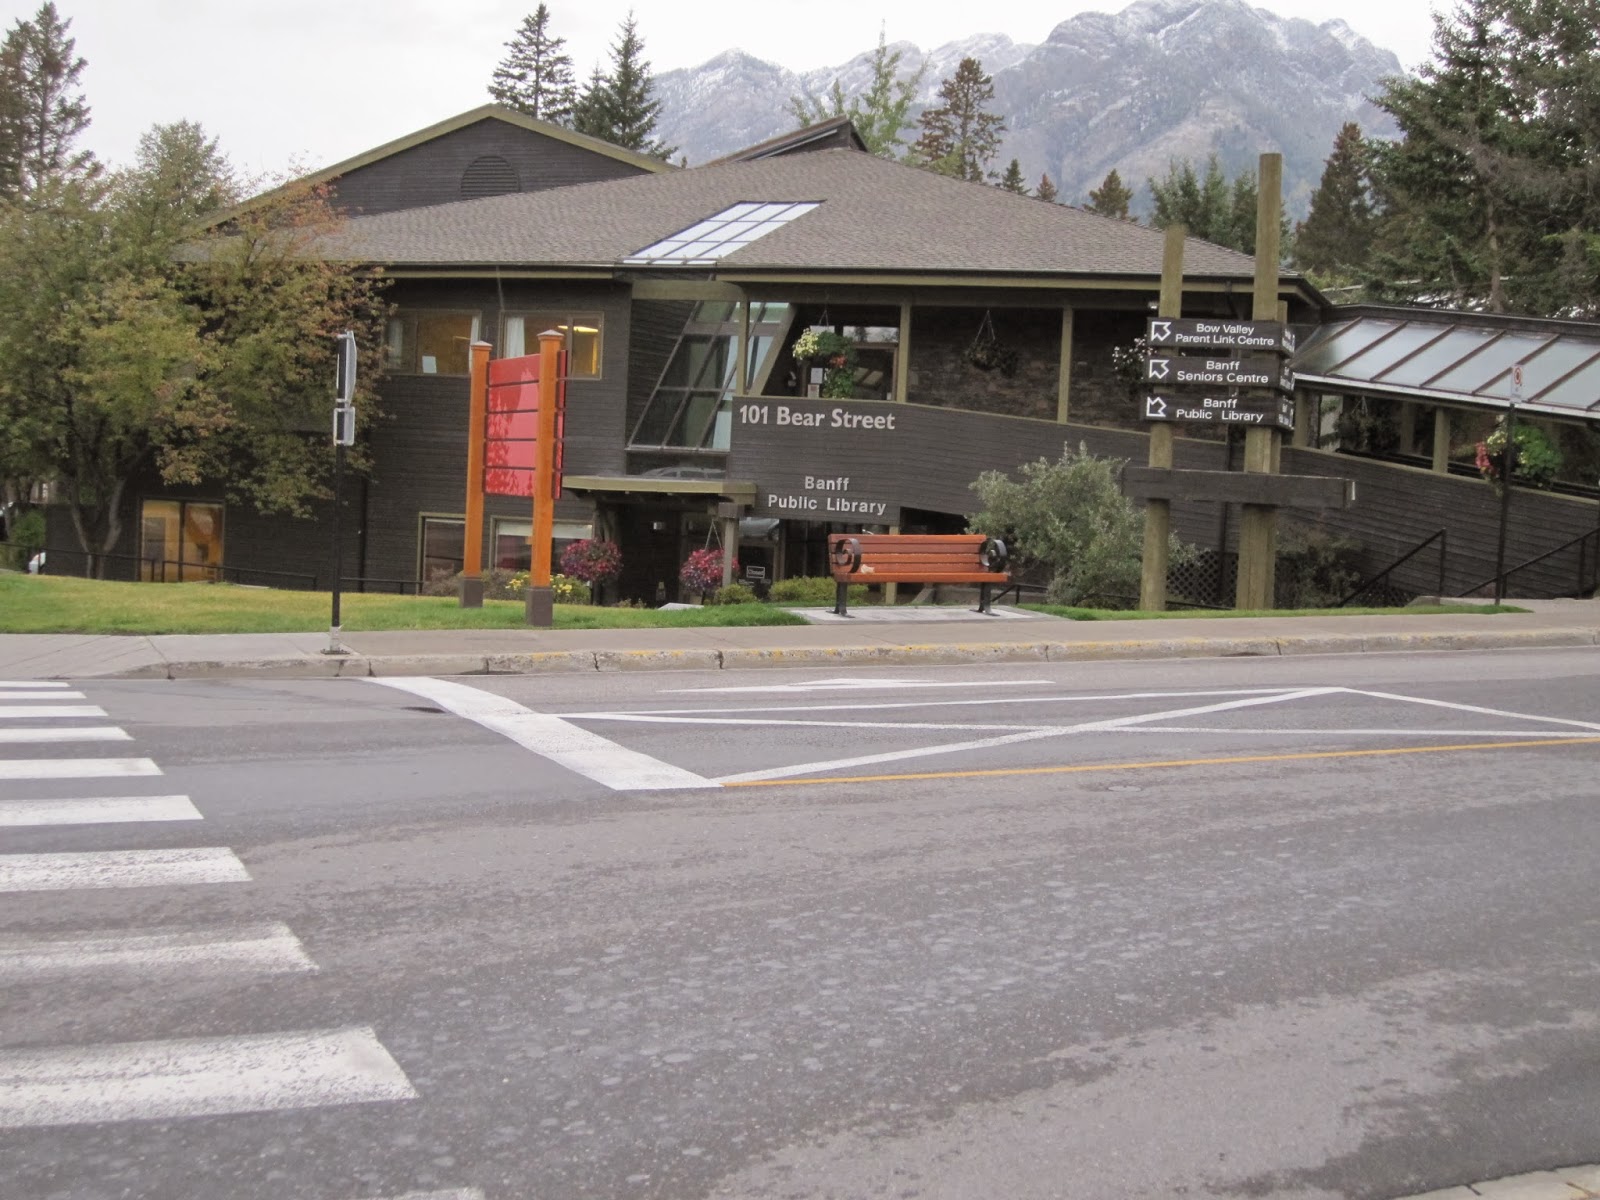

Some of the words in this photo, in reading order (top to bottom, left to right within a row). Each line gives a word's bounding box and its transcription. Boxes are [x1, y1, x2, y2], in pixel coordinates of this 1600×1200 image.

[1196, 323, 1220, 333] Bow
[1222, 324, 1255, 336] Valley
[1175, 334, 1211, 344] Parent
[1212, 334, 1235, 344] Link
[1237, 335, 1275, 346] Centre
[1206, 361, 1240, 371] Banff
[1177, 370, 1224, 382] Seniors
[1226, 372, 1269, 384] Centre
[1203, 398, 1238, 409] Banff
[739, 404, 769, 425] 101
[776, 406, 826, 427] Bear
[830, 408, 896, 430] Street
[1176, 409, 1213, 420] Public
[1221, 409, 1264, 423] Library
[804, 476, 850, 491] Banff
[768, 494, 818, 510] Public
[826, 497, 886, 516] Library
